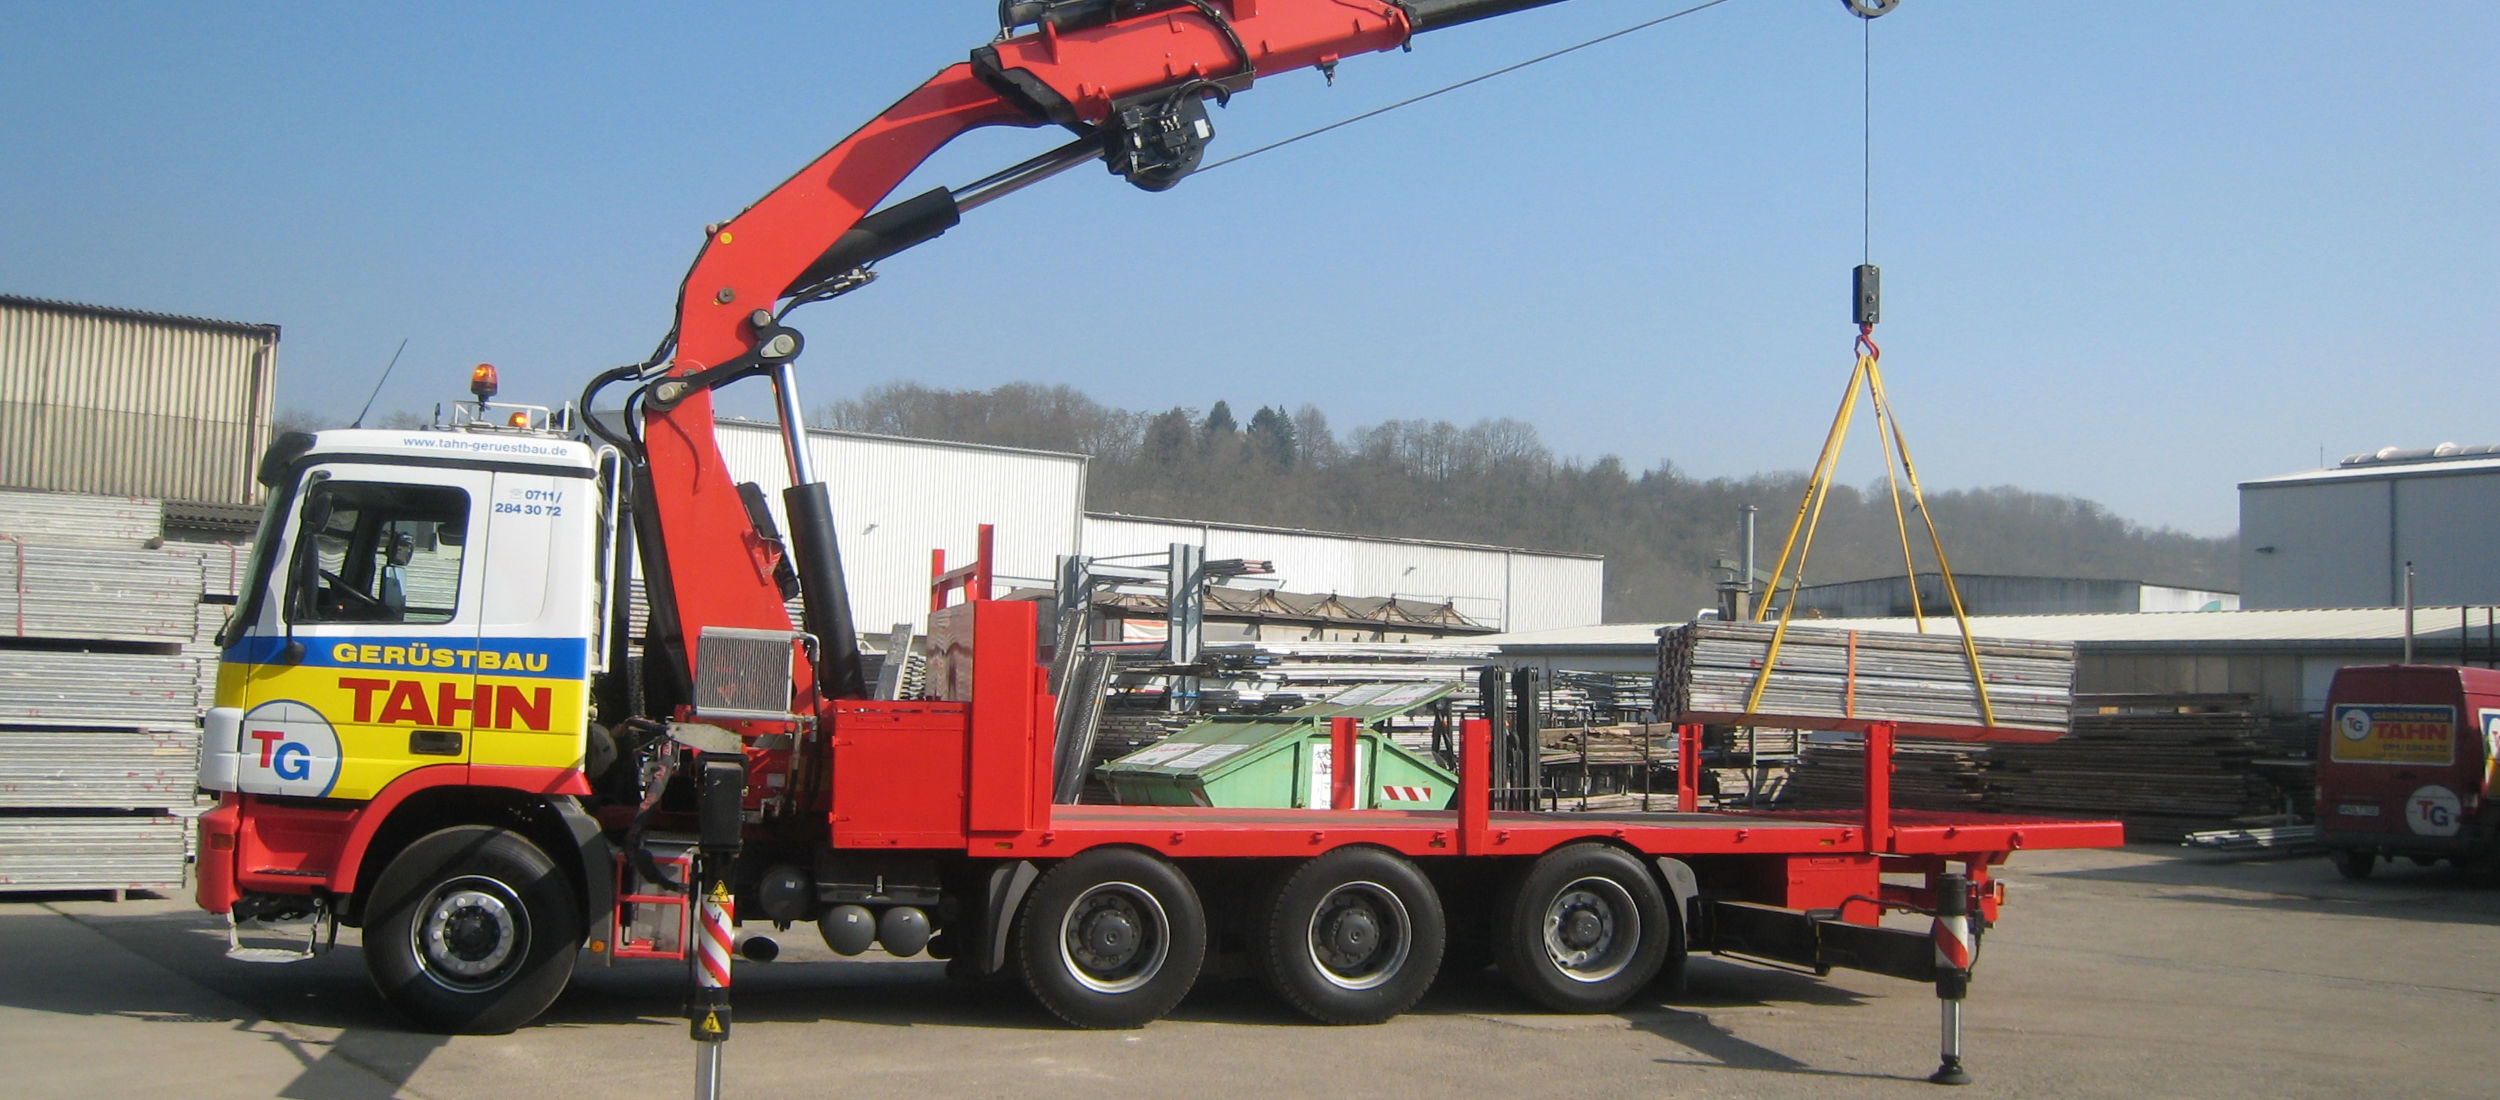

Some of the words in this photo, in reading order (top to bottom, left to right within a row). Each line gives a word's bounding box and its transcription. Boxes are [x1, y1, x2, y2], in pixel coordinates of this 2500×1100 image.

[403, 437, 568, 456] www.tahn-geruestbau.de
[525, 490, 562, 503] 0711/
[495, 502, 522, 514] 284
[525, 504, 542, 515] 30
[546, 505, 561, 517] 72
[332, 642, 548, 672] GERÜSTBAU
[338, 677, 552, 732] TAHN
[2346, 716, 2363, 732] TG
[2373, 722, 2447, 740] TAHN
[252, 730, 311, 781] TG
[2416, 800, 2449, 827] TG
